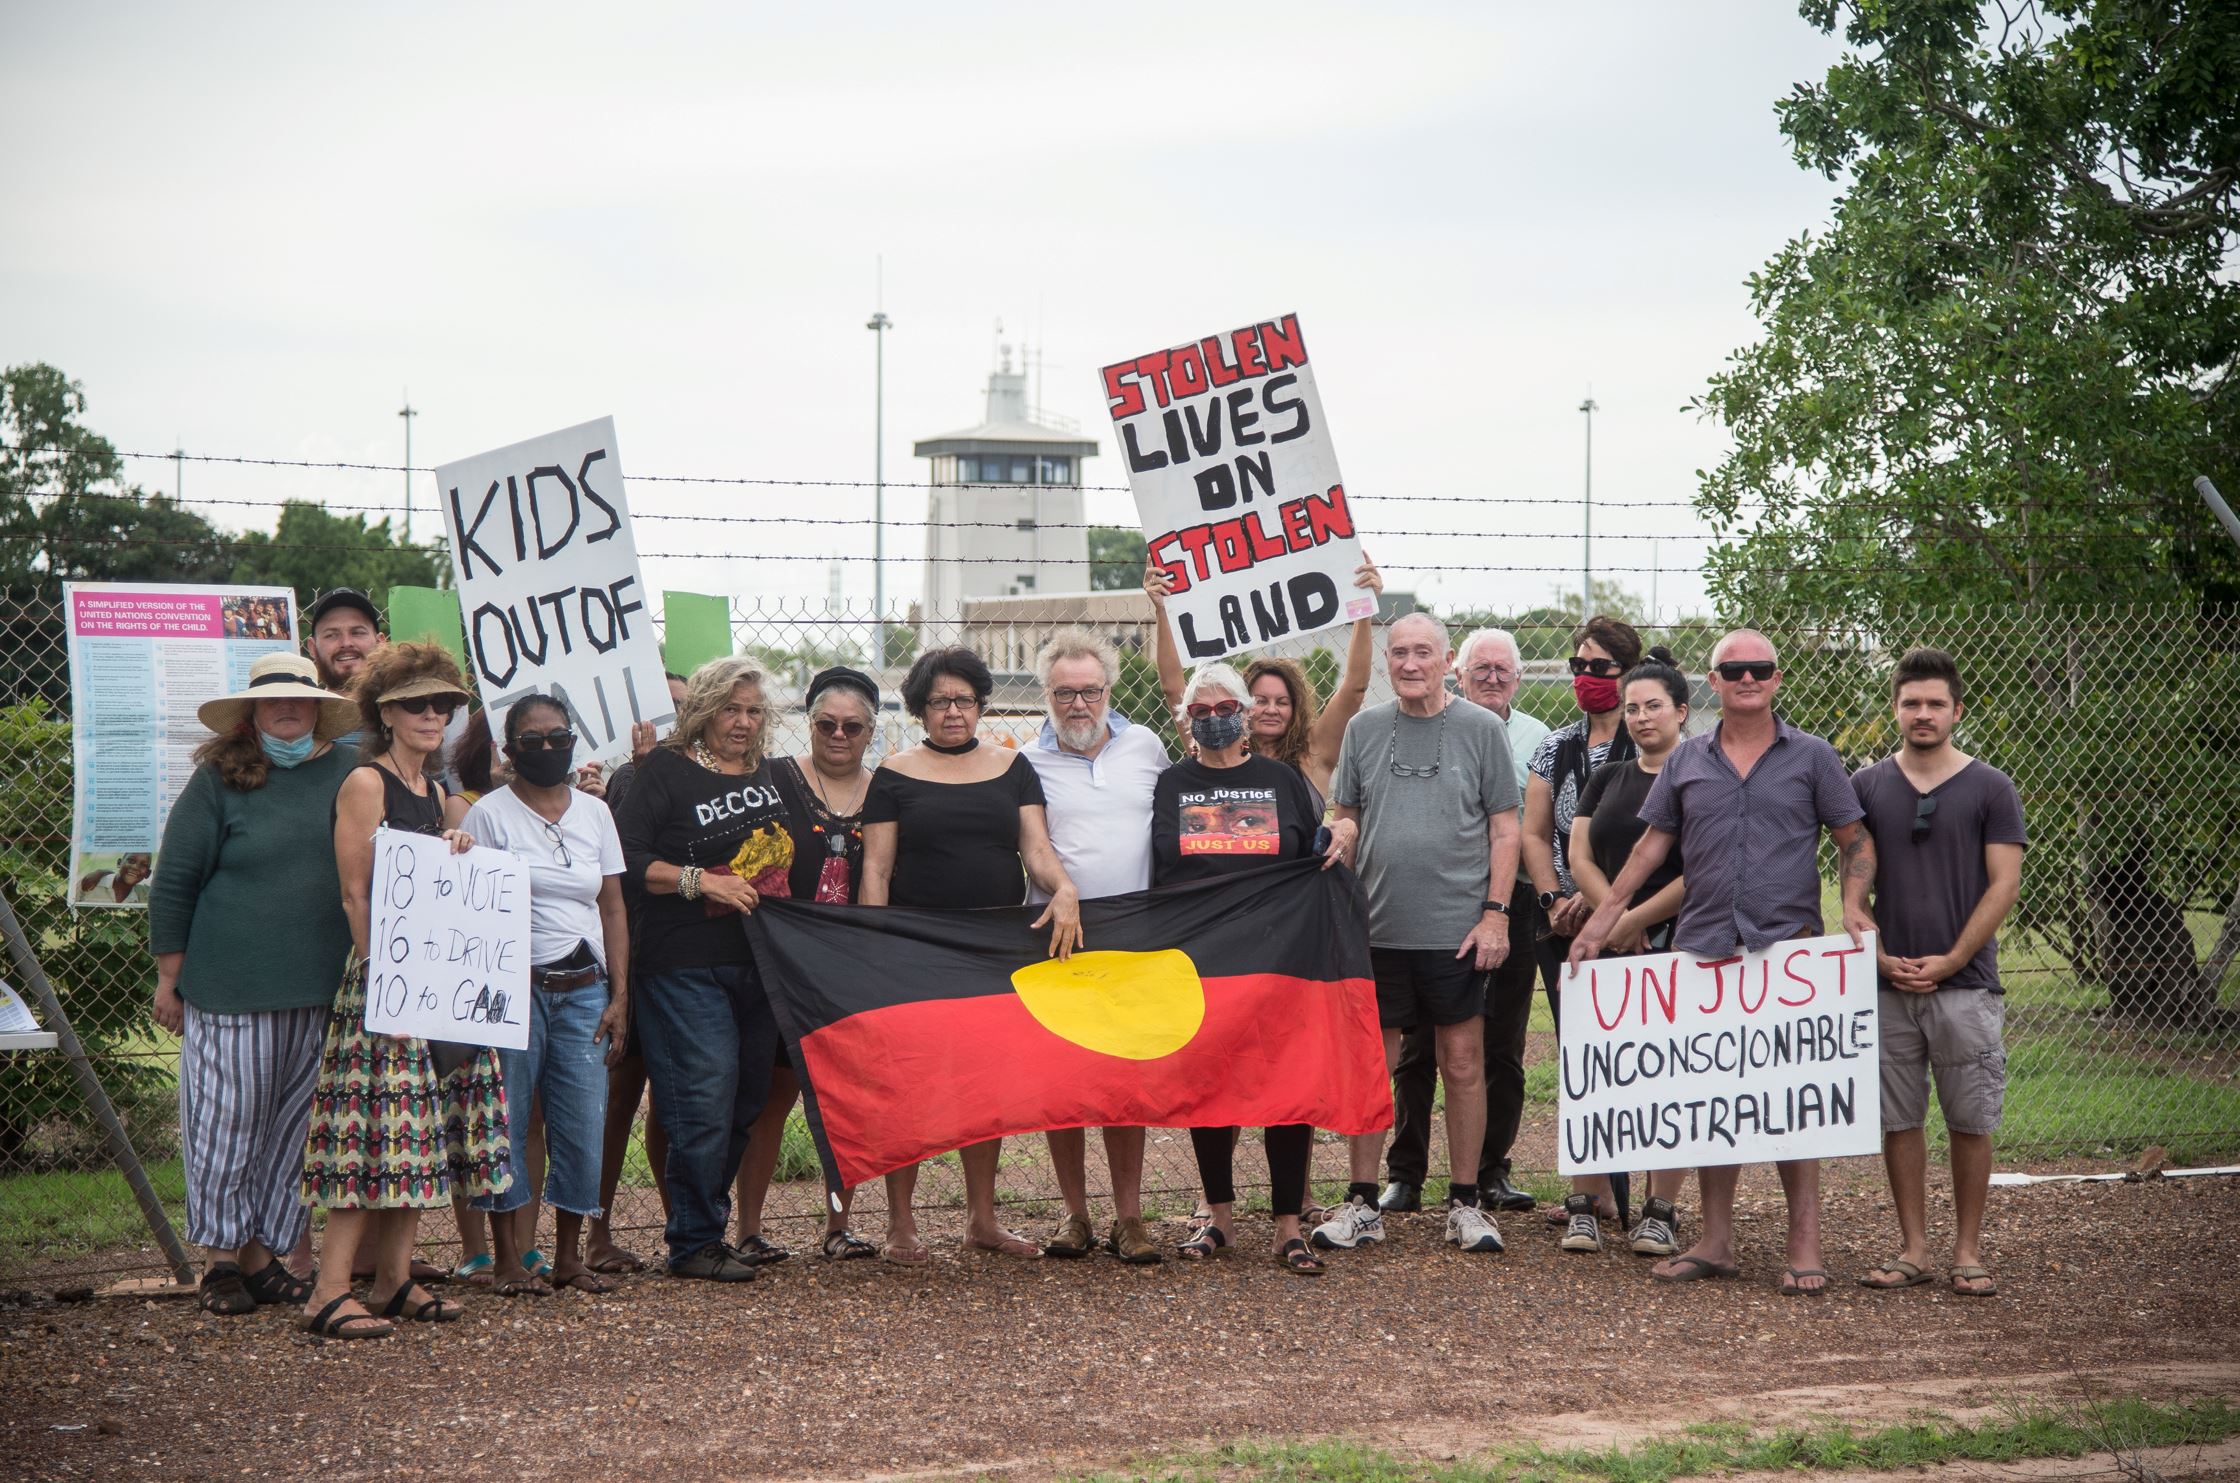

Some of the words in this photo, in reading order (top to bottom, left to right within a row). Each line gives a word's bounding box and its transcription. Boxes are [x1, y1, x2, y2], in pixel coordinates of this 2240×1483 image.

[1102, 312, 1309, 420] STOLEN
[1122, 373, 1311, 473] LIVES
[1194, 450, 1276, 511] ON
[450, 449, 621, 581] KIDS
[1148, 484, 1356, 595] STOLEN
[88, 601, 134, 609] SIMPLIFIED
[137, 602, 174, 610] VERSION
[115, 612, 152, 620] NATIONS
[116, 622, 147, 630] RIGHTS
[1178, 571, 1339, 658] LAND
[1182, 794, 1205, 803] NO
[1210, 790, 1272, 800] JUSTICE
[1186, 840, 1236, 850] JUST
[1244, 840, 1270, 849] US
[384, 844, 415, 909] 18
[434, 866, 453, 899] to
[458, 862, 516, 913] VOTE
[379, 916, 409, 963] 16
[424, 930, 440, 961] to
[448, 928, 516, 974] DRIVE
[375, 974, 408, 1018] 10
[417, 985, 438, 1012] to
[1563, 1009, 1874, 1101] UNCONSCIONABLE
[1566, 1077, 1854, 1165] UNAUSTRALIAN
